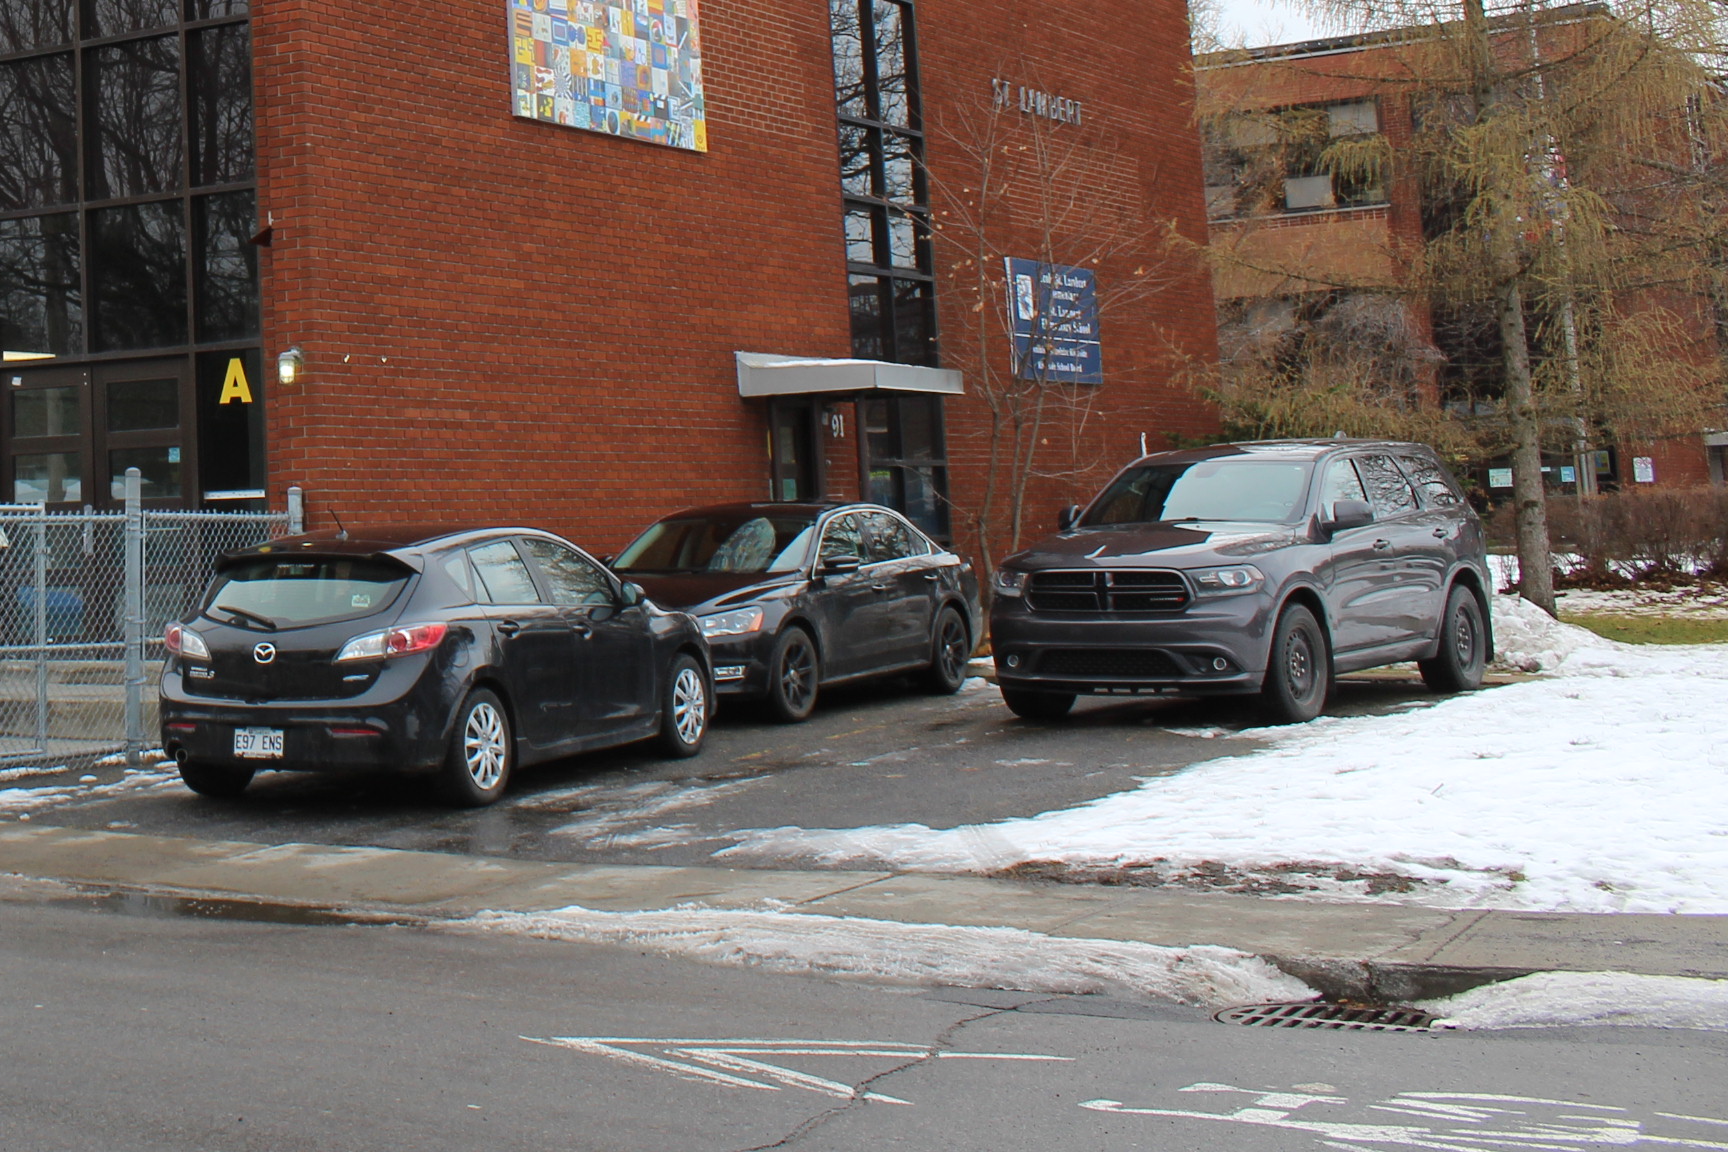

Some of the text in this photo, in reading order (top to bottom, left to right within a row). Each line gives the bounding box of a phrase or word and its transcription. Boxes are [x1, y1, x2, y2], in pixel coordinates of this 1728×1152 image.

[1019, 86, 1081, 126] LAMBERT
[219, 358, 252, 404] A
[831, 414, 844, 438] 91
[235, 734, 282, 751] E97 ENS
